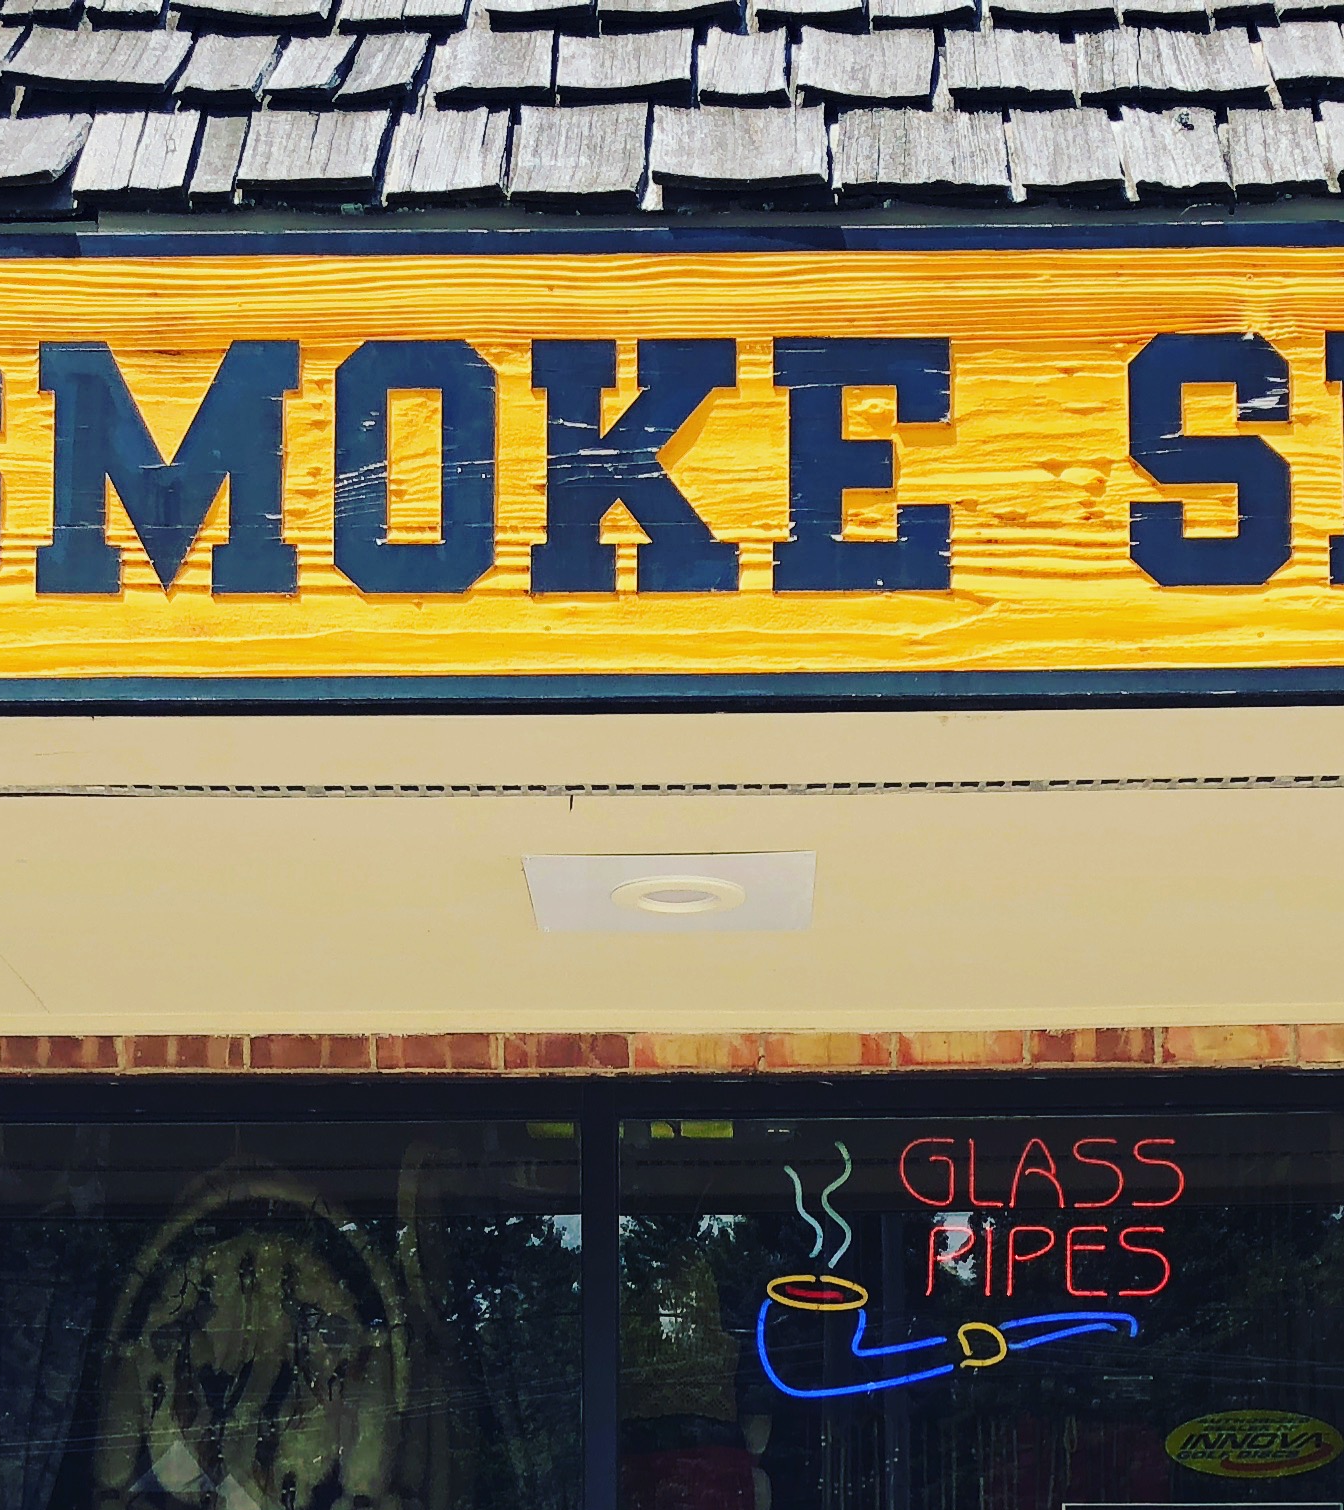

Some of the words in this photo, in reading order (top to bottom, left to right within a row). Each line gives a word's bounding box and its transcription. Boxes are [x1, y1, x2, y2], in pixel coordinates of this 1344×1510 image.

[899, 1138, 1185, 1209] GLASS
[925, 1226, 1170, 1297] PIPES
[1179, 1432, 1324, 1450] INNOVA
